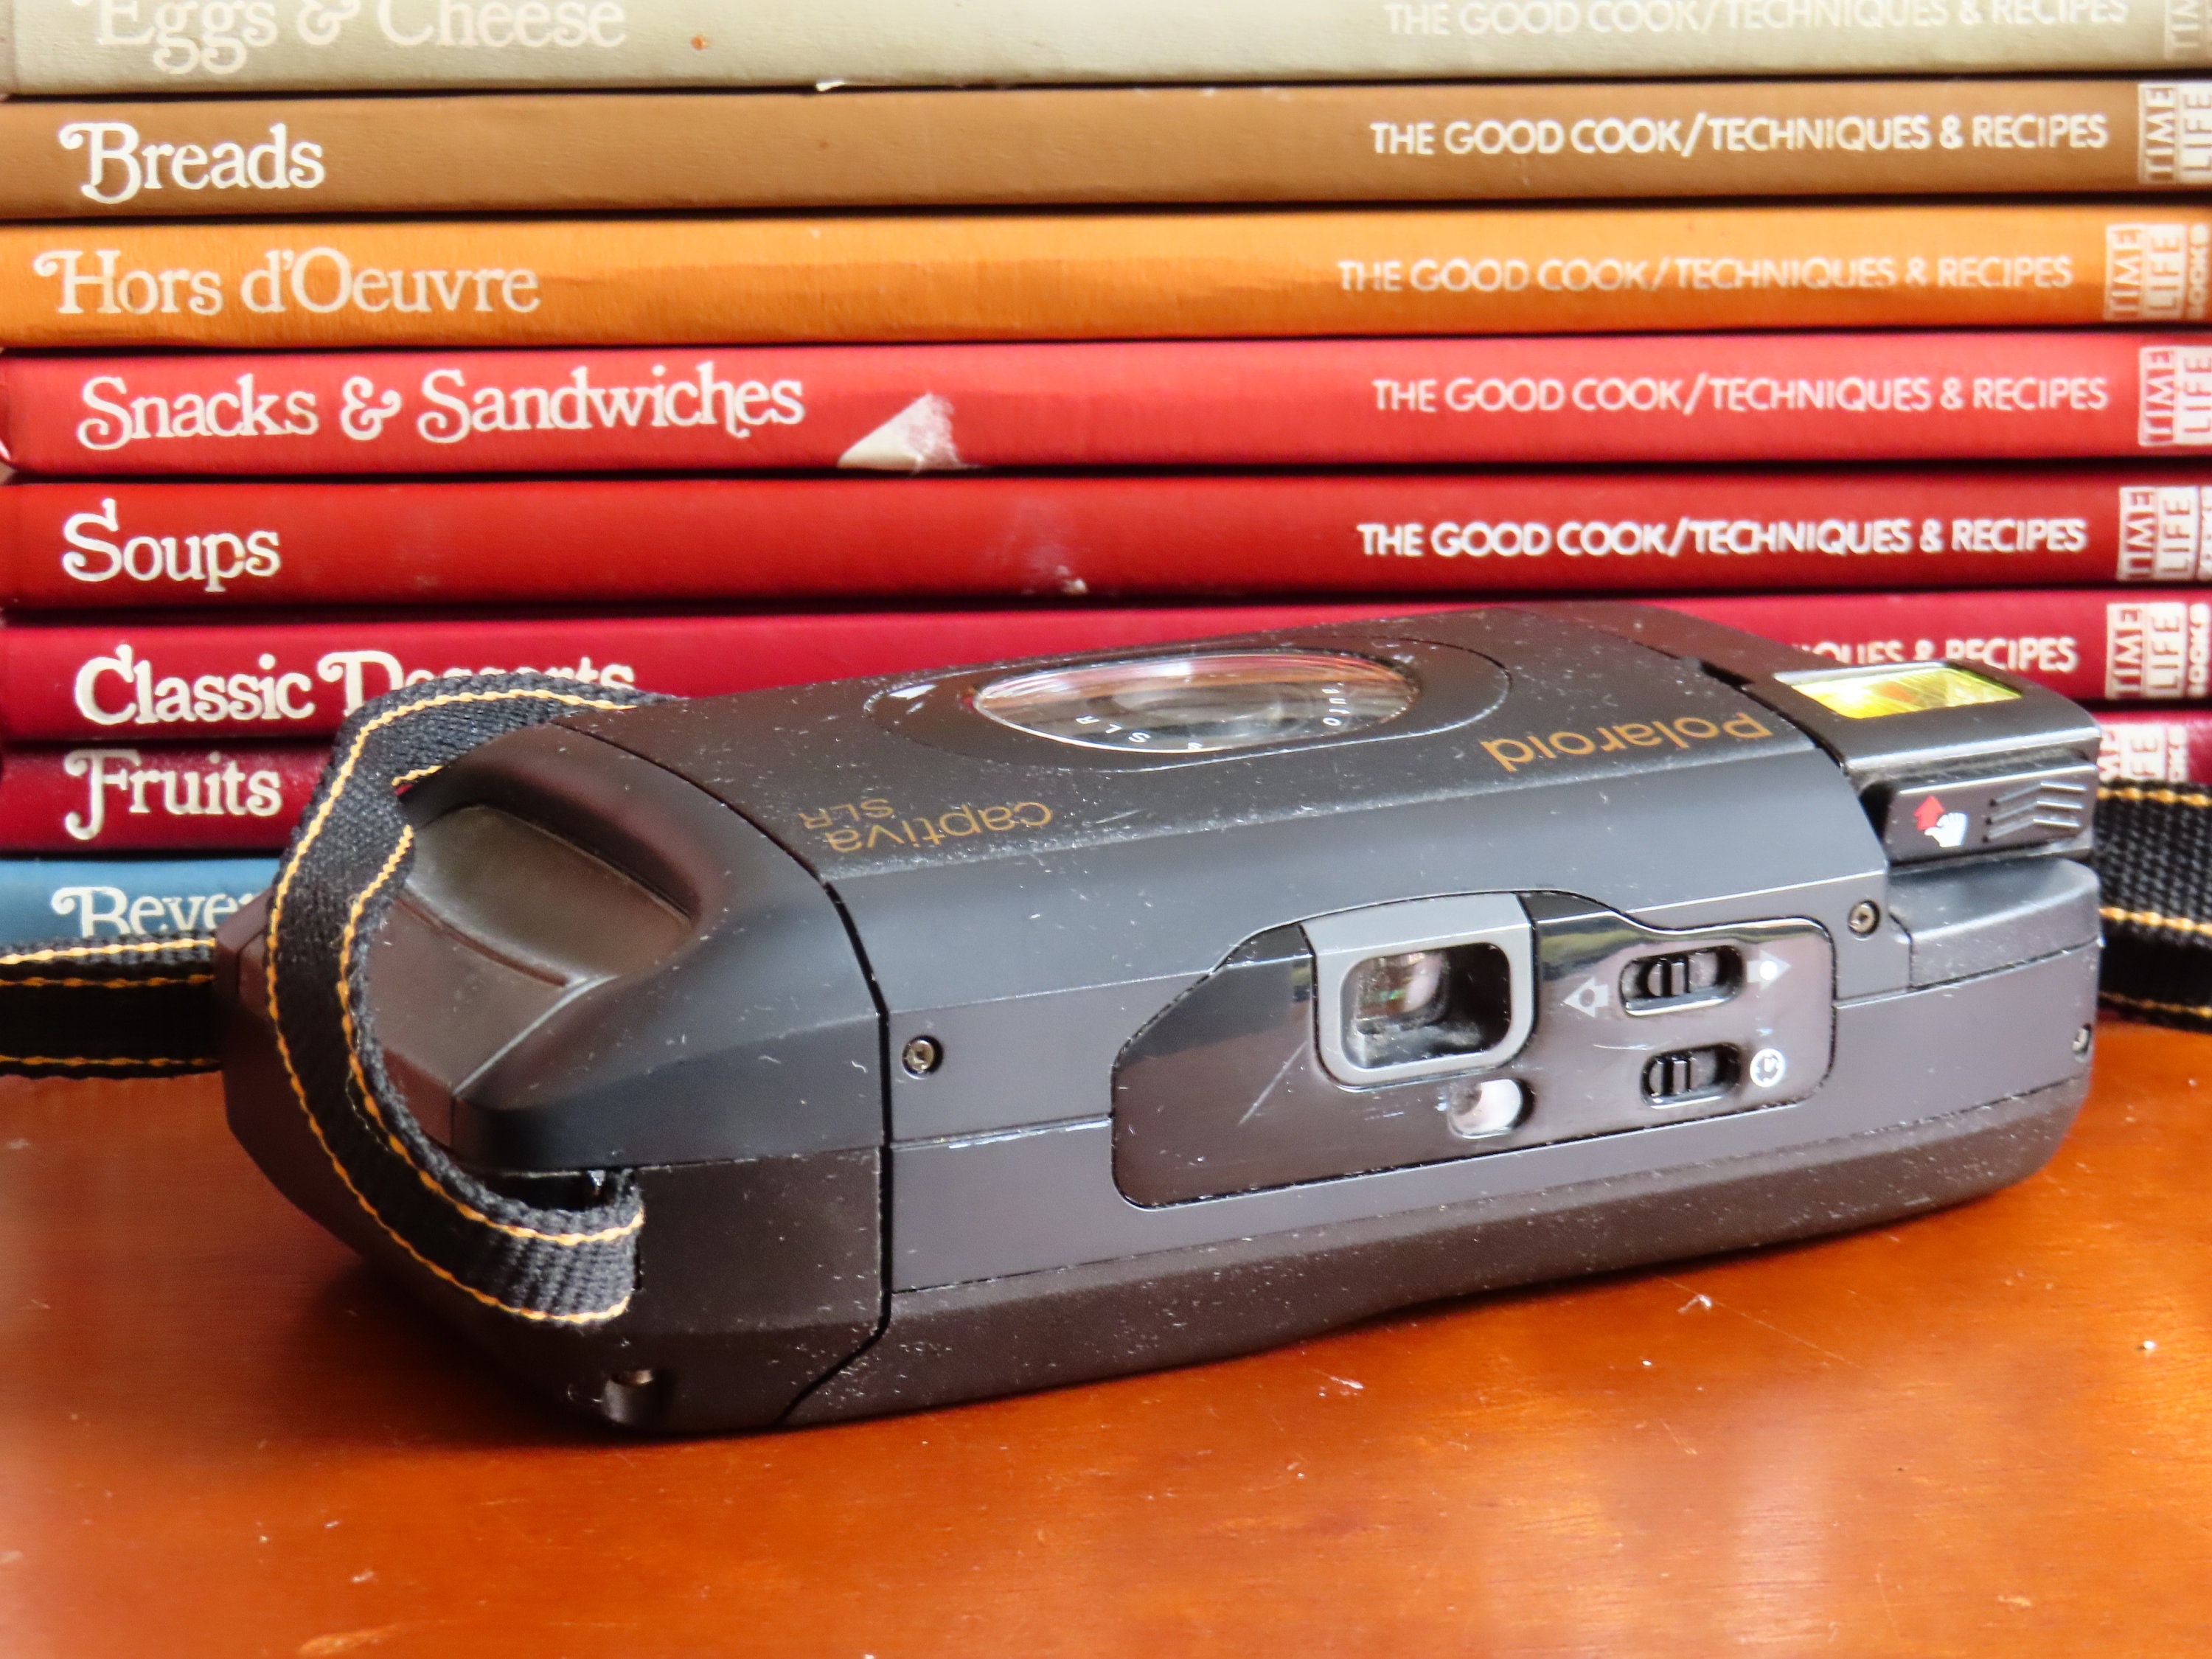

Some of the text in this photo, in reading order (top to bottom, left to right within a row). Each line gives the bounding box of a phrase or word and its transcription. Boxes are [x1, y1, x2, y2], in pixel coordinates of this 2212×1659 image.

[77, 0, 627, 74] Eggs & Cheese
[1384, 3, 1450, 35] THE
[1458, 1, 1581, 35] GOOD
[1958, 0, 1984, 25] &
[1991, 0, 2129, 24] RECIPES
[59, 122, 326, 204] Breads
[1369, 119, 1436, 155] THE
[1444, 117, 1565, 155] GOOD
[1938, 114, 1964, 149] &
[1972, 113, 2110, 148] RECIPES
[2145, 87, 2175, 181] TIME
[2183, 94, 2212, 170] LIFE
[33, 247, 541, 316] Hors d'Oeuvre
[1337, 260, 1403, 291] THE
[1409, 257, 1530, 291] GOOD
[1905, 257, 1929, 288] &
[1937, 254, 2075, 288] RECIPES
[2111, 228, 2141, 320] TIME
[2149, 237, 2179, 310] LIFE
[76, 359, 805, 450] Snacks & Sandwiches
[1371, 378, 1438, 413] THE
[1444, 377, 1566, 412] GOOD
[1939, 378, 1964, 411] &
[1972, 377, 2109, 411] RECIPES
[2145, 350, 2175, 443] TIME
[2183, 357, 2212, 434] LIFE
[60, 498, 281, 591] Soups
[1357, 523, 1424, 557] THE
[1430, 521, 1552, 557] GOOD
[1919, 518, 1944, 553] &
[1952, 518, 2087, 553] RECIPES
[2124, 491, 2156, 580] TIME
[2161, 498, 2191, 572] LIFE
[74, 644, 315, 726] Classic
[2112, 608, 2143, 698] TIME
[2151, 616, 2180, 689] LIFE
[1075, 714, 1152, 744] SLR
[1480, 712, 1773, 773] Polaroid
[64, 750, 282, 840] Fruits
[798, 798, 894, 830] SLR
[824, 801, 1052, 853] captiva
